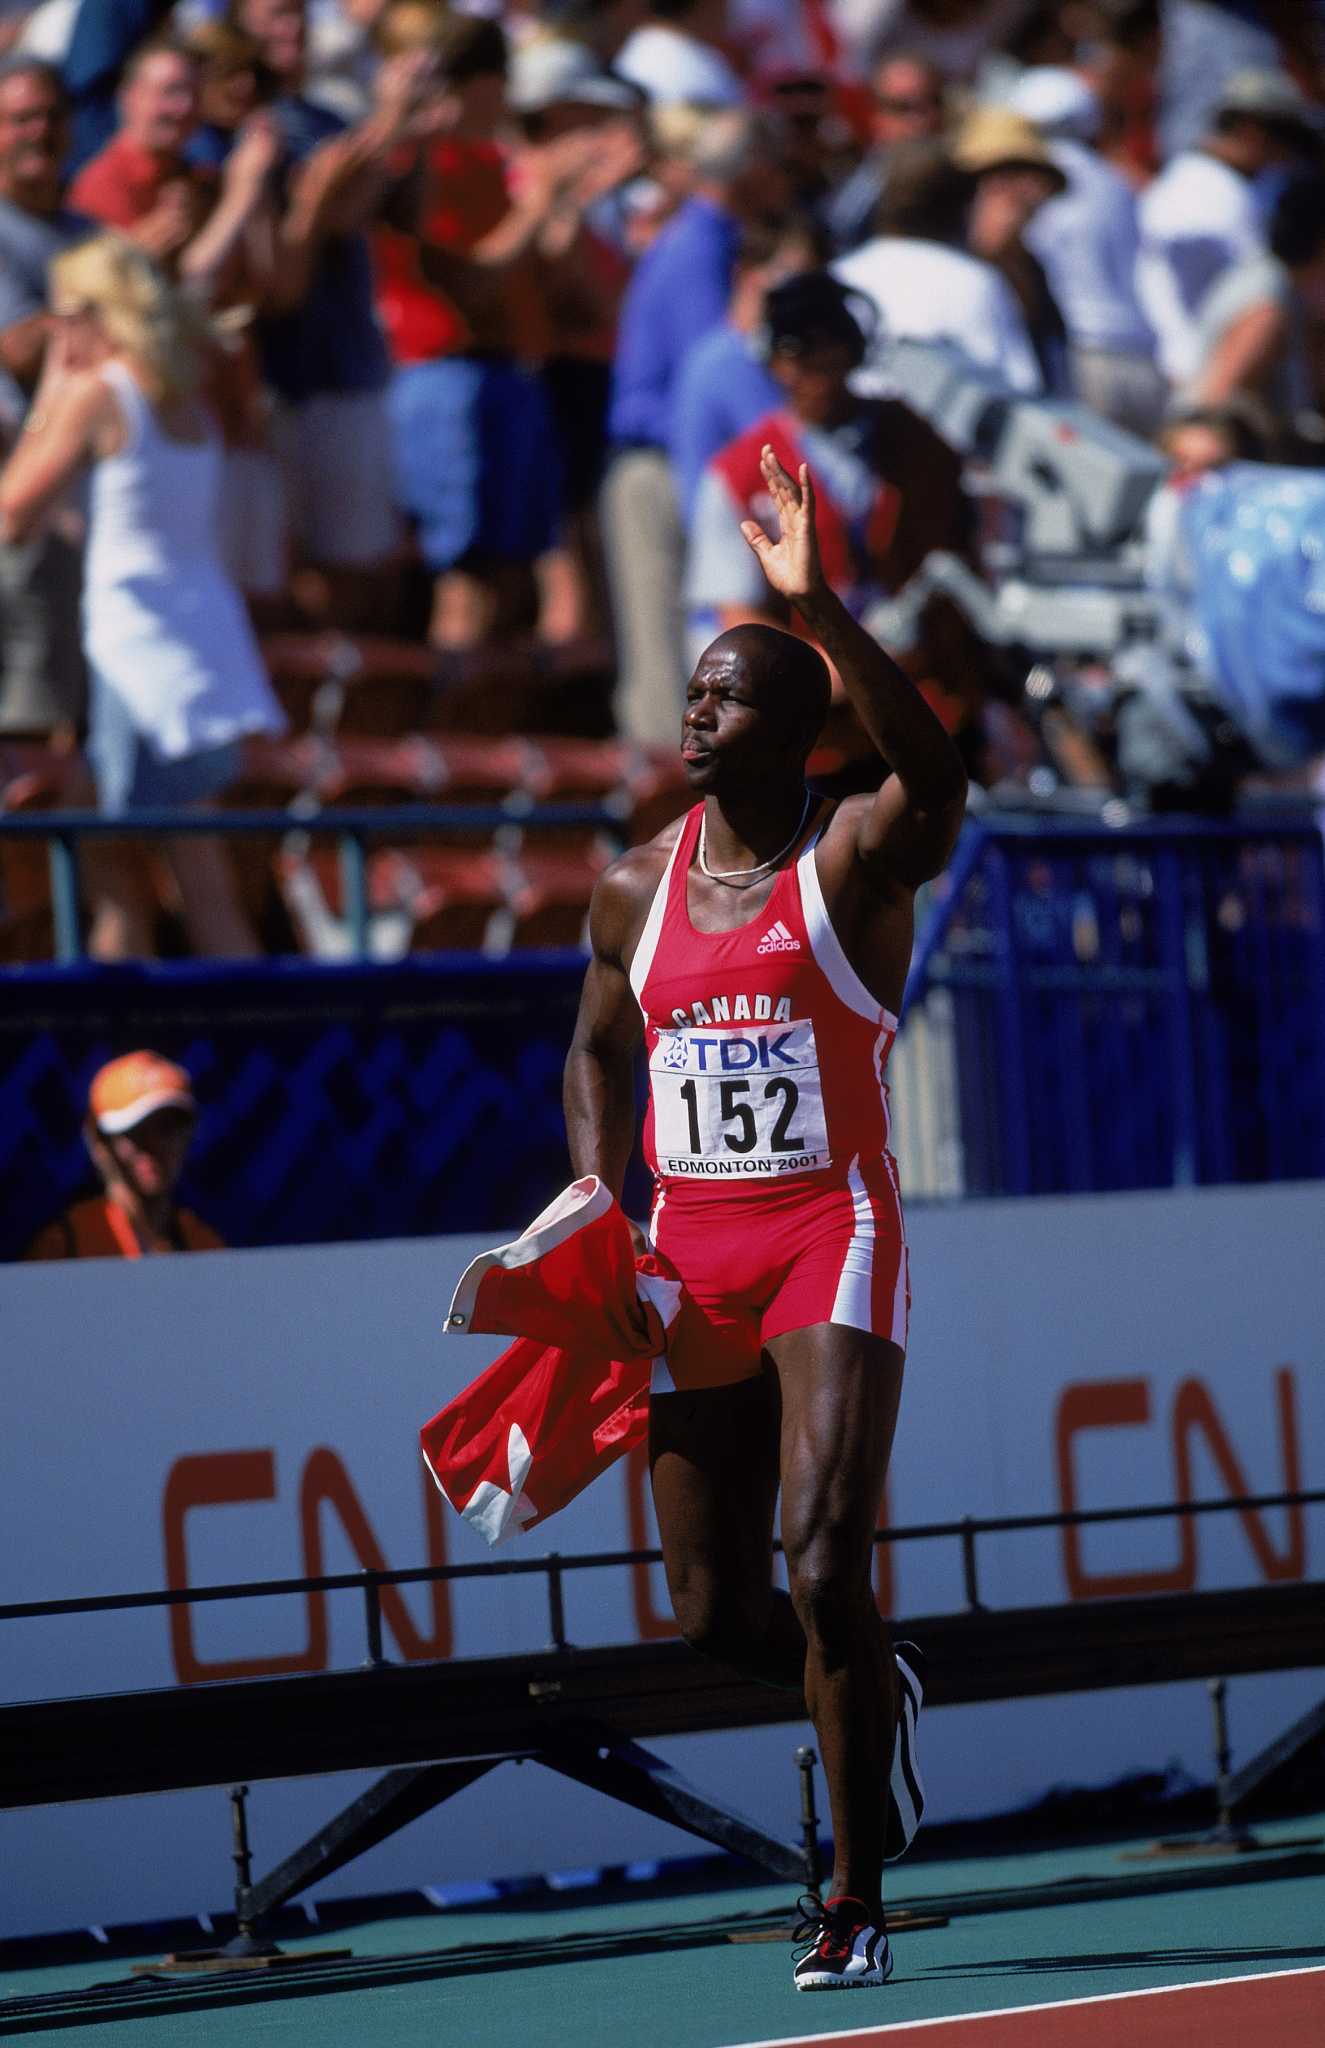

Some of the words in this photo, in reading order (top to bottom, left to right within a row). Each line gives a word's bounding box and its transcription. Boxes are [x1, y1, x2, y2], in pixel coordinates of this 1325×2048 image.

[757, 939, 801, 954] adidas
[671, 994, 791, 1028] CANADA
[690, 1031, 800, 1071] TDK
[680, 1077, 805, 1155] 152
[668, 1159, 772, 1174] EDMONTON
[777, 1155, 818, 1170] 2001
[1055, 1366, 1306, 1600] CN
[163, 1444, 454, 1685] CN
